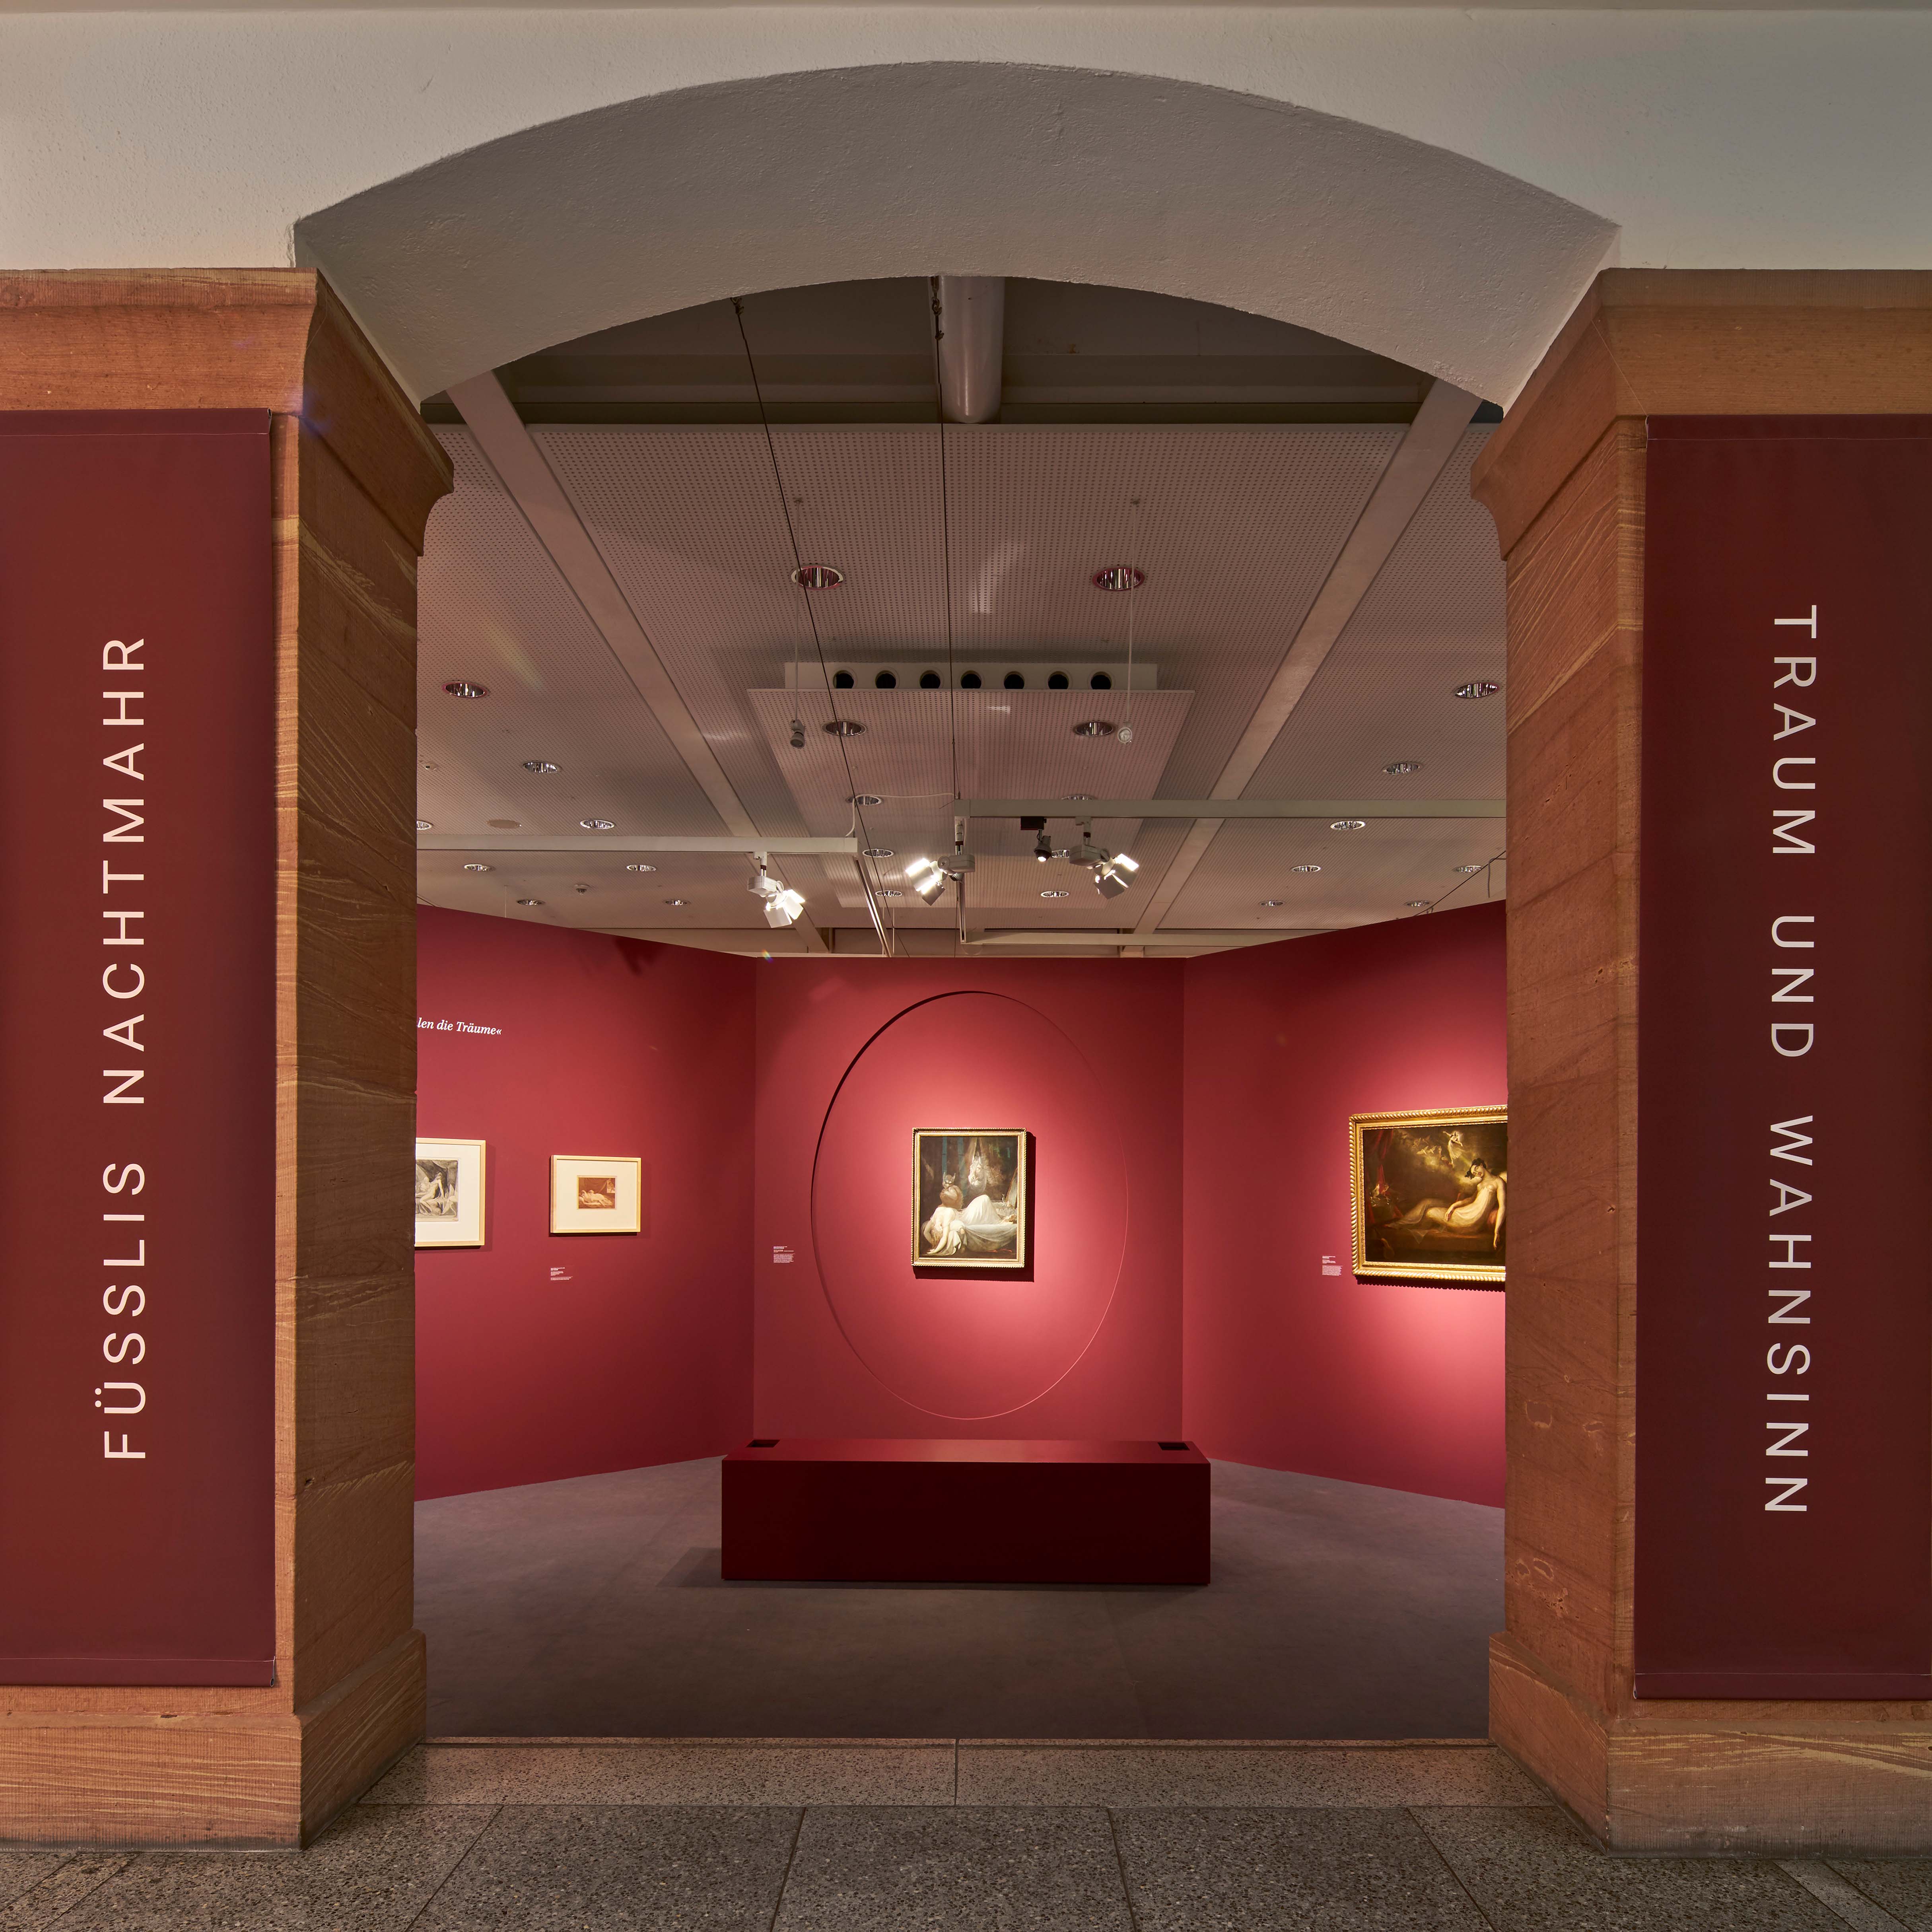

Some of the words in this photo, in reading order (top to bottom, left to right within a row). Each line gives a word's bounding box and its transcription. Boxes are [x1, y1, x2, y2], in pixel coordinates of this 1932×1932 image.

[1773, 604, 1817, 853] TRAUM
[102, 638, 145, 1104] NACHTMAHR
[1771, 916, 1815, 1057] UND
[416, 1017, 434, 1029] len
[436, 1019, 453, 1031] die
[456, 1021, 502, 1035] Träume«
[95, 1163, 146, 1459] FÜSSLIS
[1765, 1115, 1813, 1512] WAHNSINN
